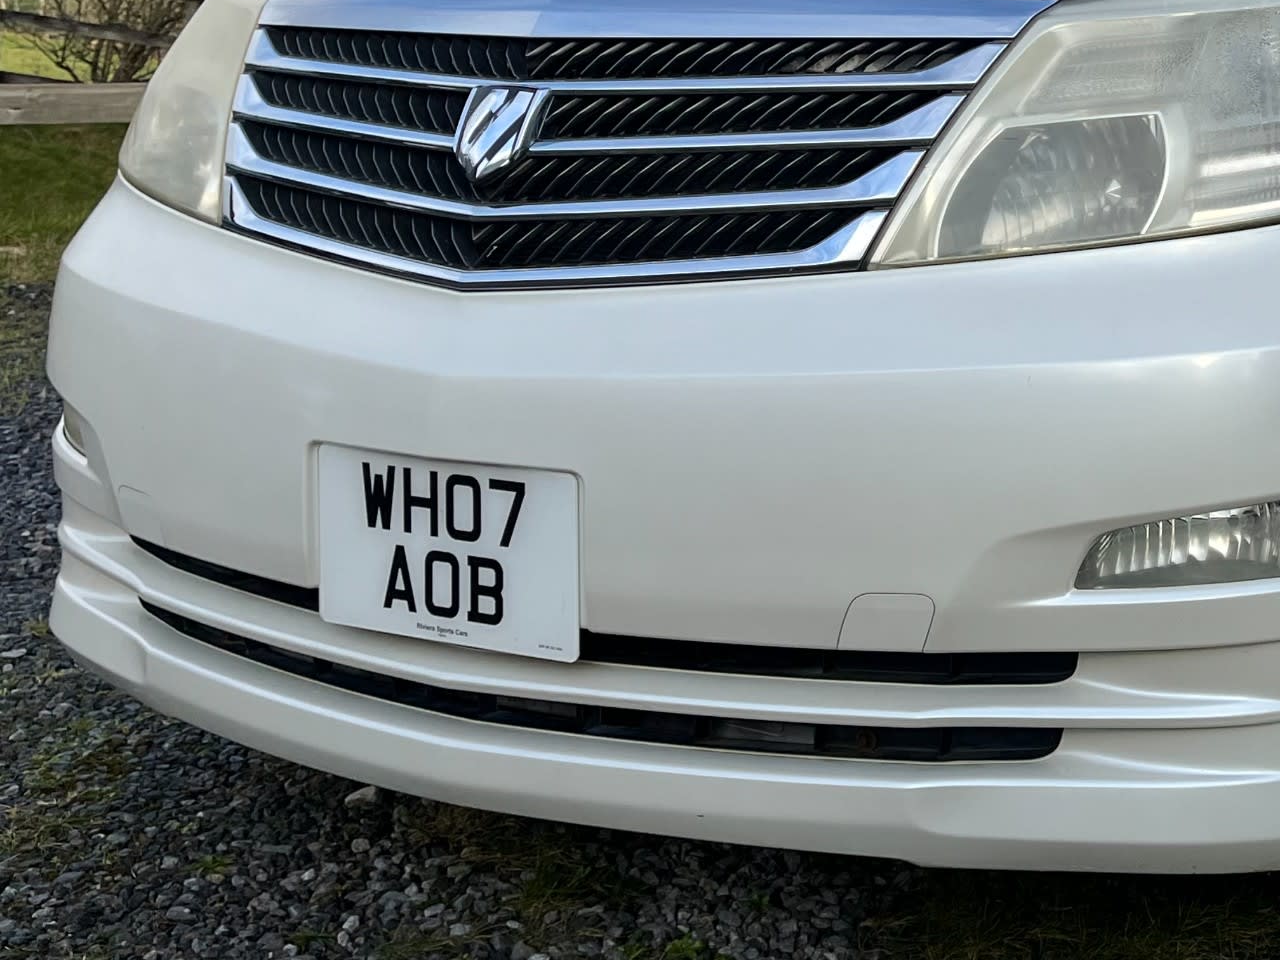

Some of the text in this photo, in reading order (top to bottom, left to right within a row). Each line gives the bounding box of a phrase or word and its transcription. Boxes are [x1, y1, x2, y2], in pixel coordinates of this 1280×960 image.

[361, 461, 525, 547] WH07
[383, 544, 504, 626] AOB
[455, 628, 468, 637] Cars
